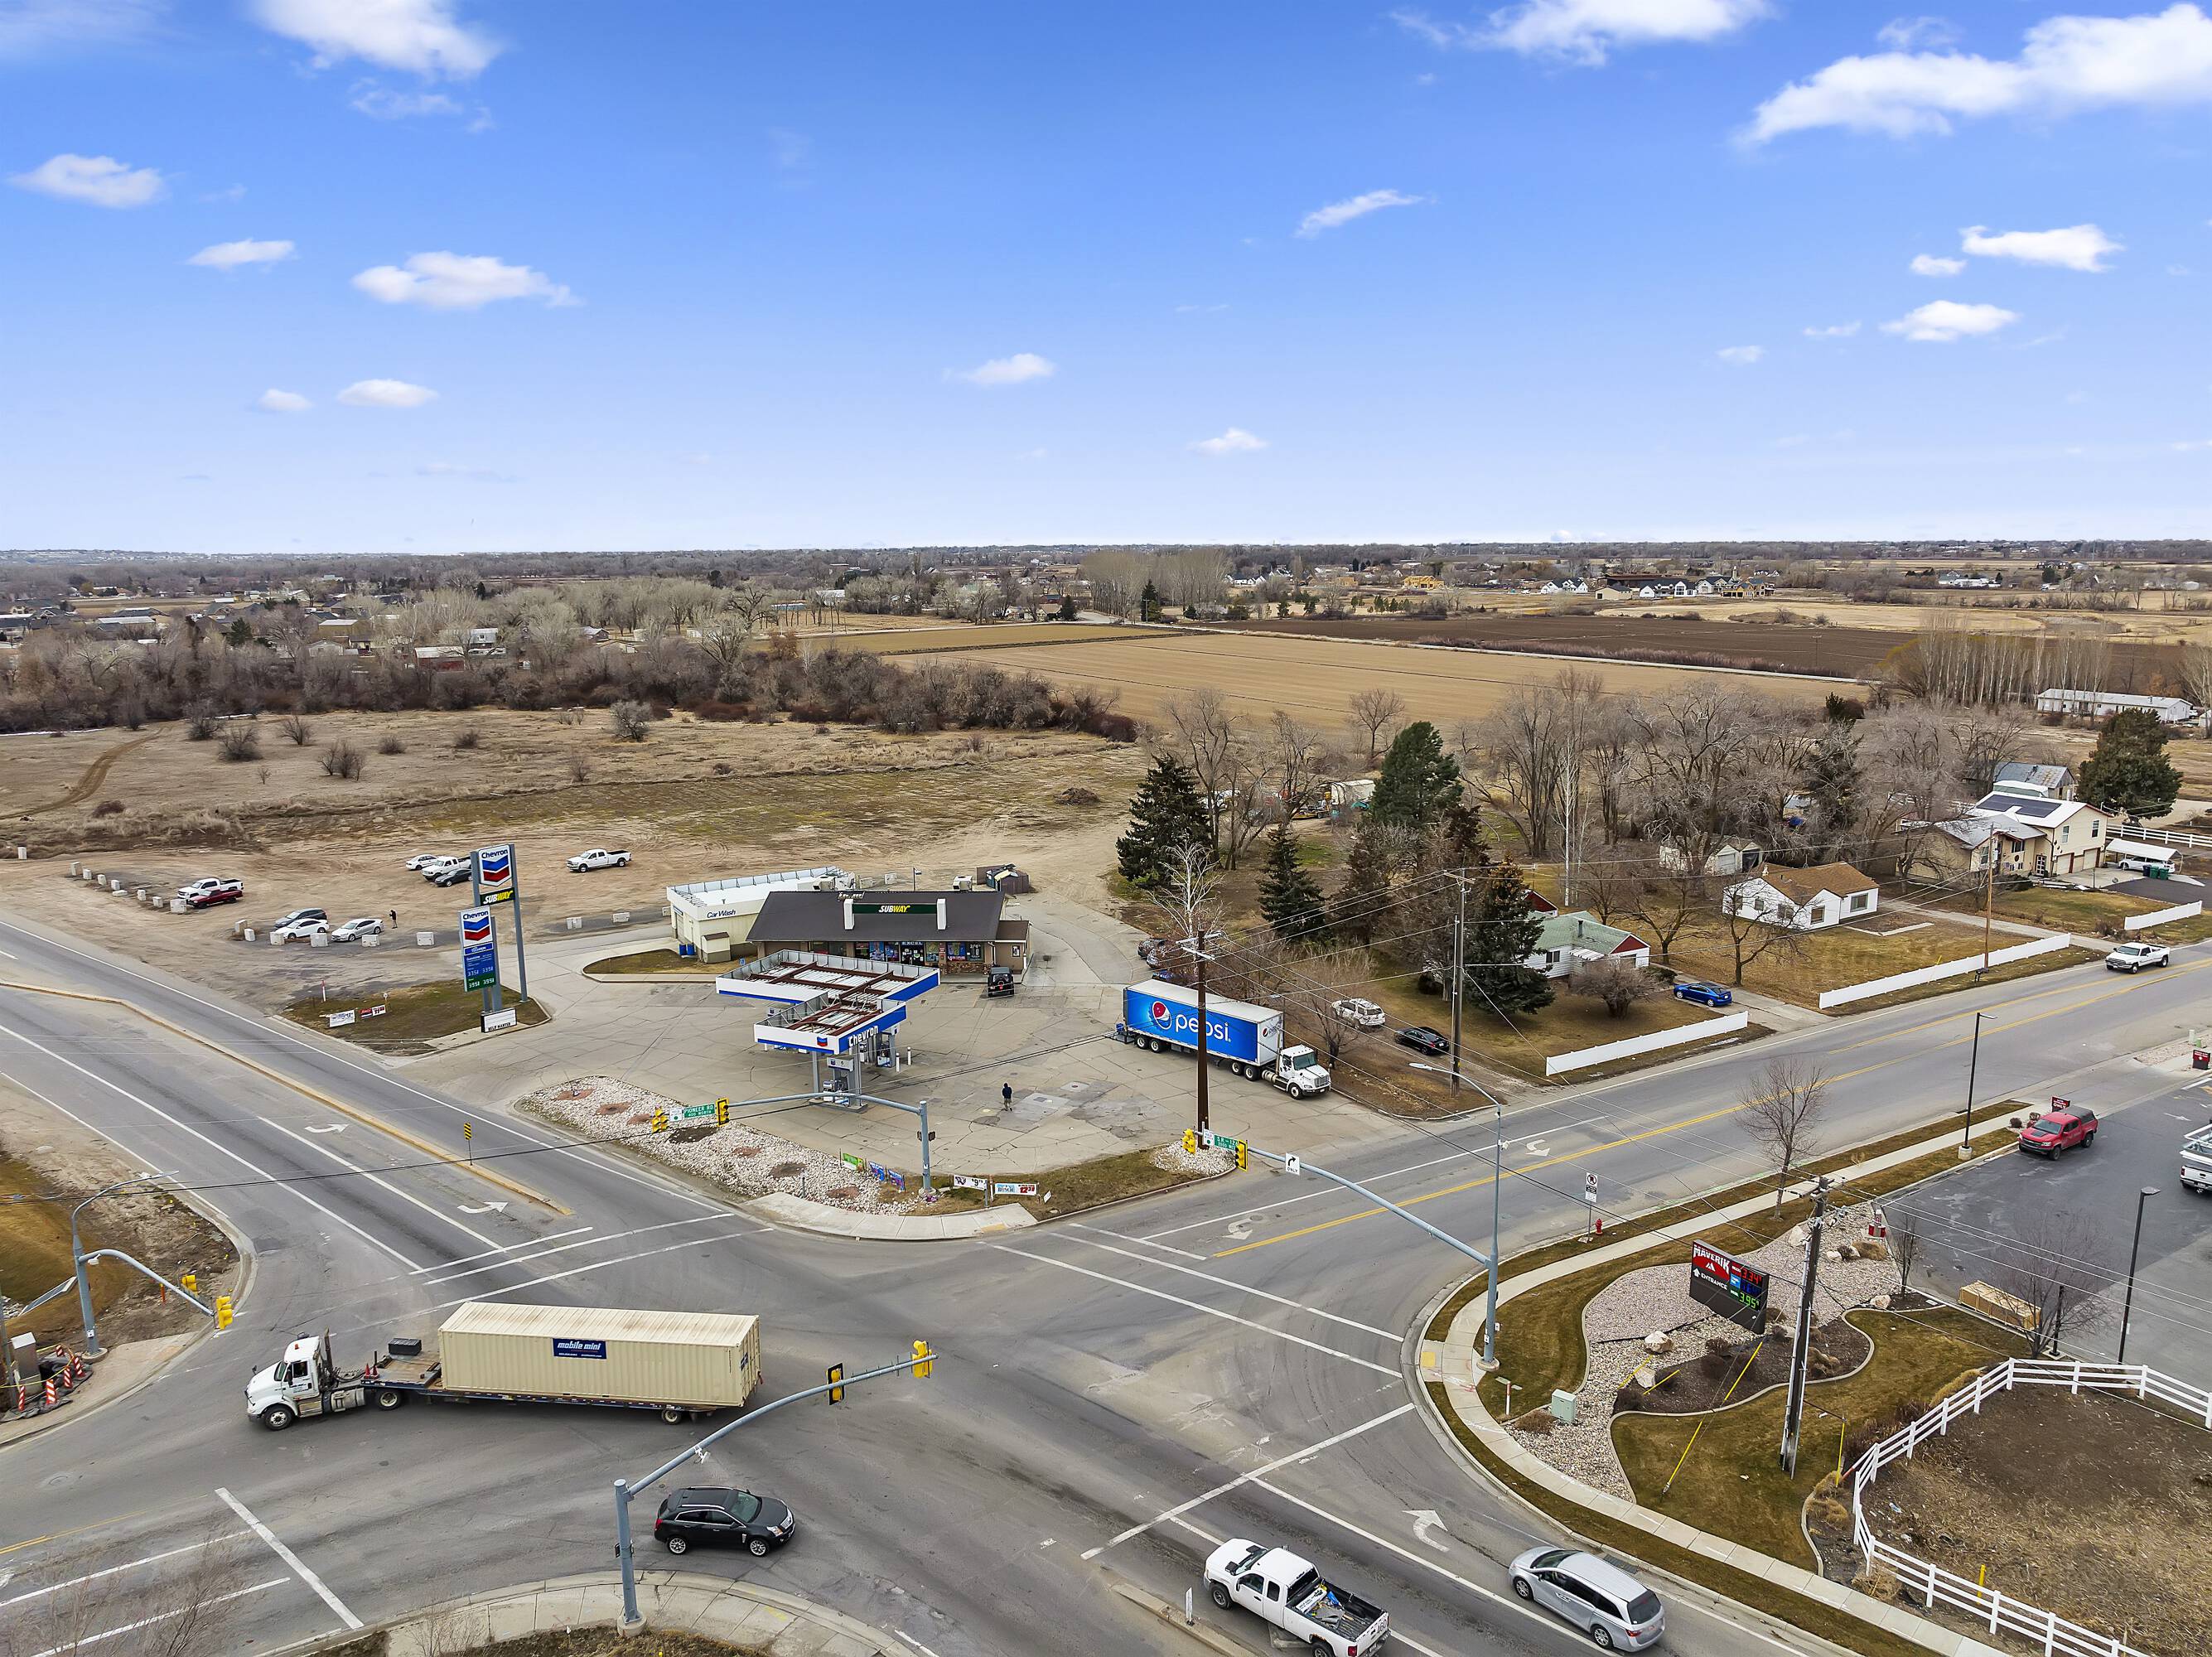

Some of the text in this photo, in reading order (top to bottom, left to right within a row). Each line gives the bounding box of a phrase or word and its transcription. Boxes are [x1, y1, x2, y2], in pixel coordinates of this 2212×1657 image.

[481, 849, 508, 858] Chevron
[483, 890, 514, 905] SUBWAY
[878, 905, 910, 913] SUBWAY
[462, 911, 489, 920] Chevron
[848, 1026, 879, 1047] Chevron
[1693, 1246, 1731, 1275] MAVERIK
[1701, 1273, 1728, 1291] ENTRANCE
[558, 1341, 583, 1350] mobile
